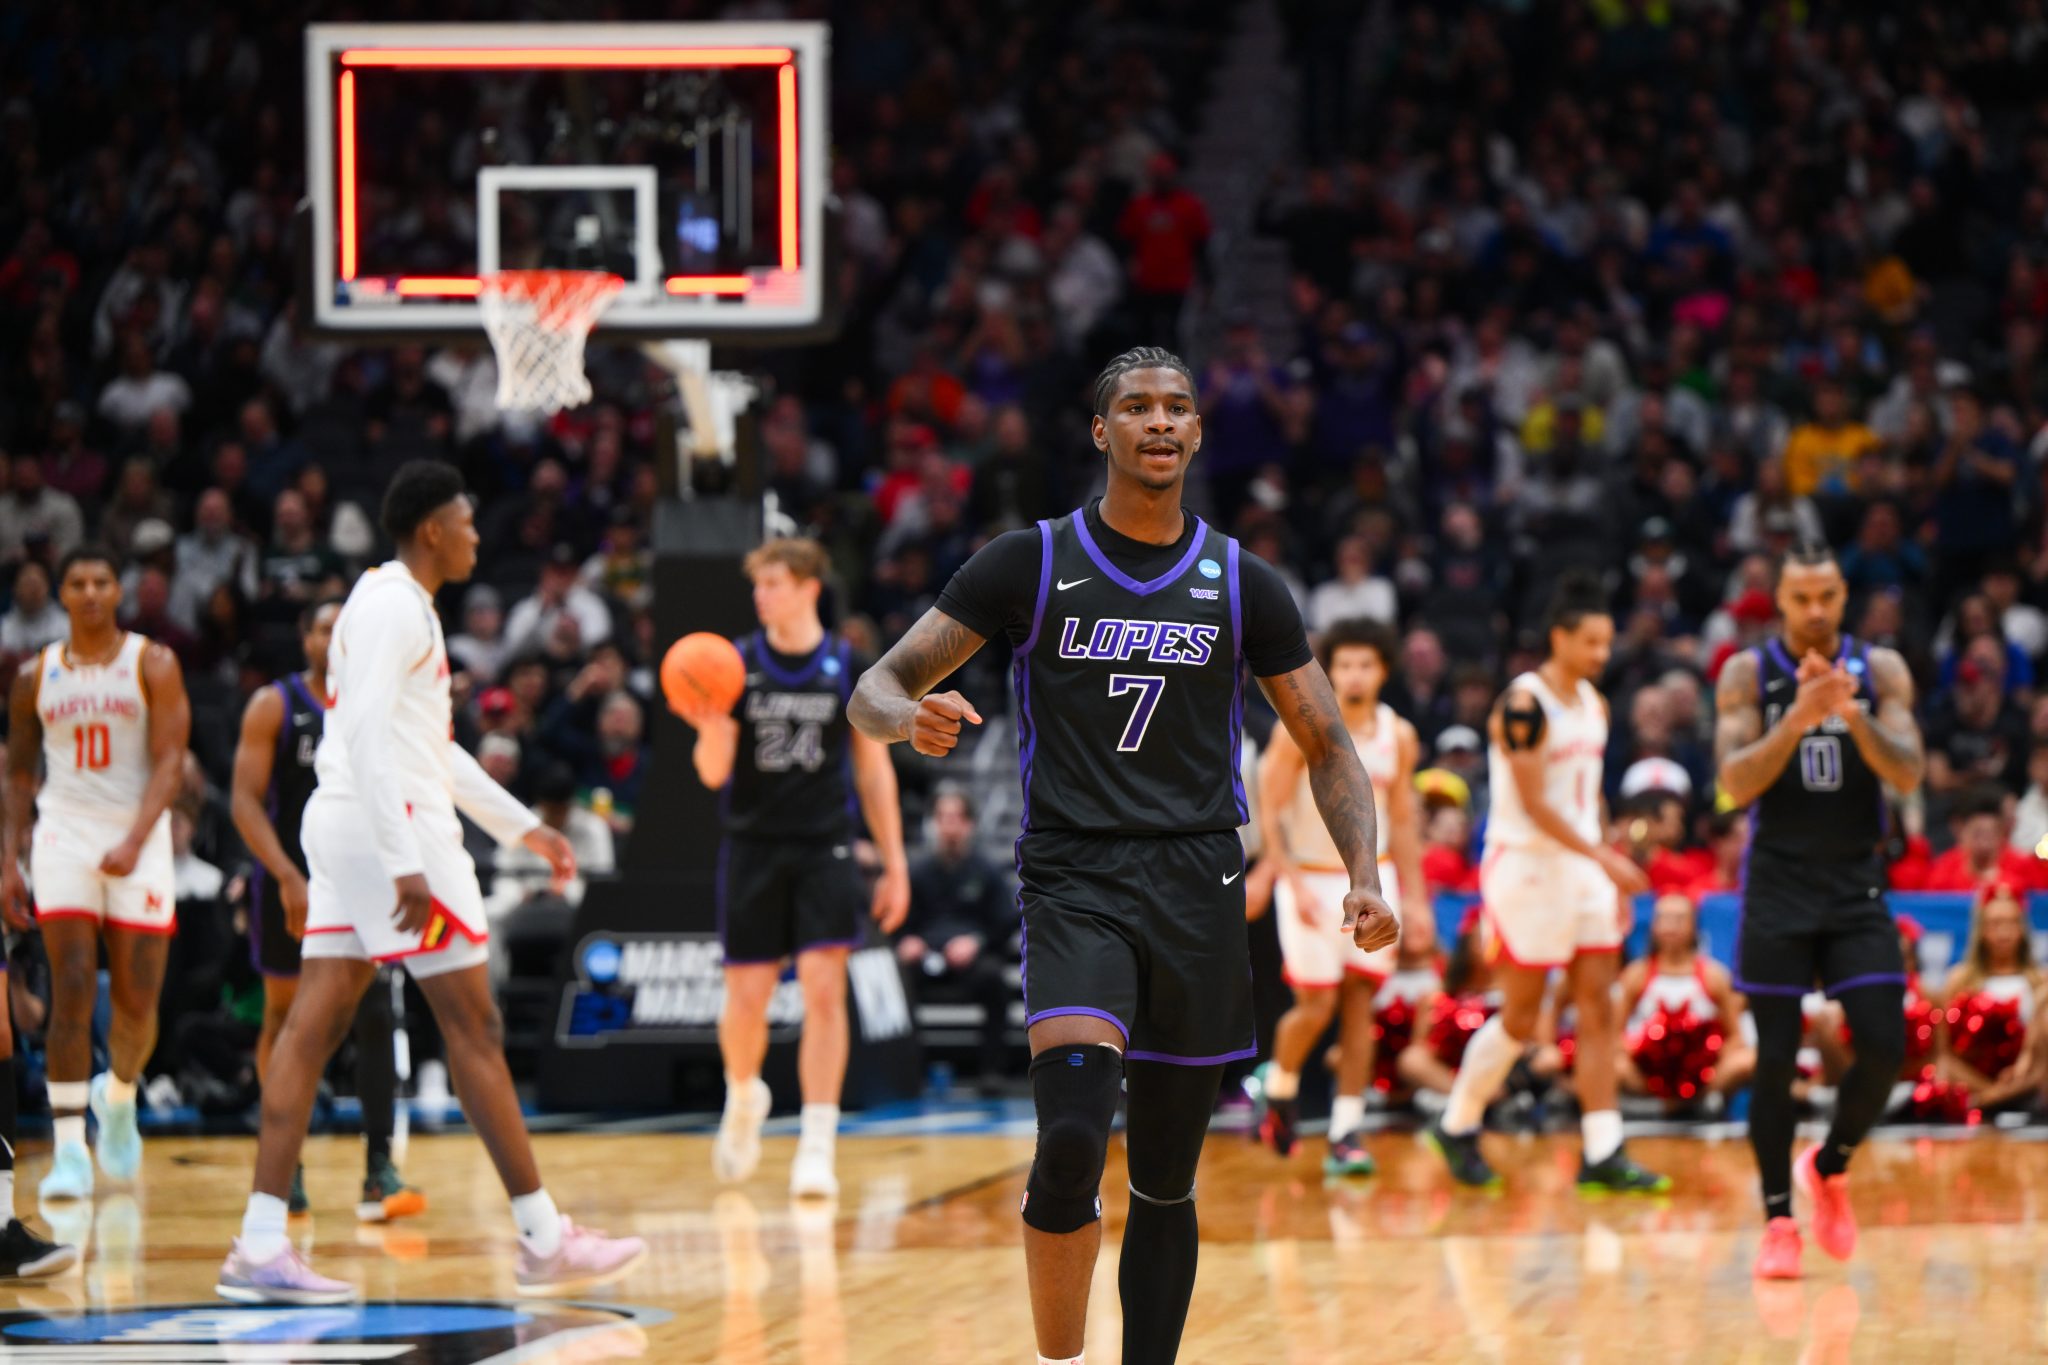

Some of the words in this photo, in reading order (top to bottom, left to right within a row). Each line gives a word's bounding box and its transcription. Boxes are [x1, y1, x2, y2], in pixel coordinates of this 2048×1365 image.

[1189, 587, 1219, 600] WAC
[1058, 617, 1219, 666] LOPES
[43, 694, 138, 726] MARYLAND
[1108, 673, 1165, 752] 7
[74, 723, 111, 770] 10
[754, 721, 827, 774] 24
[1799, 735, 1843, 793] 0
[621, 941, 724, 981] MARC
